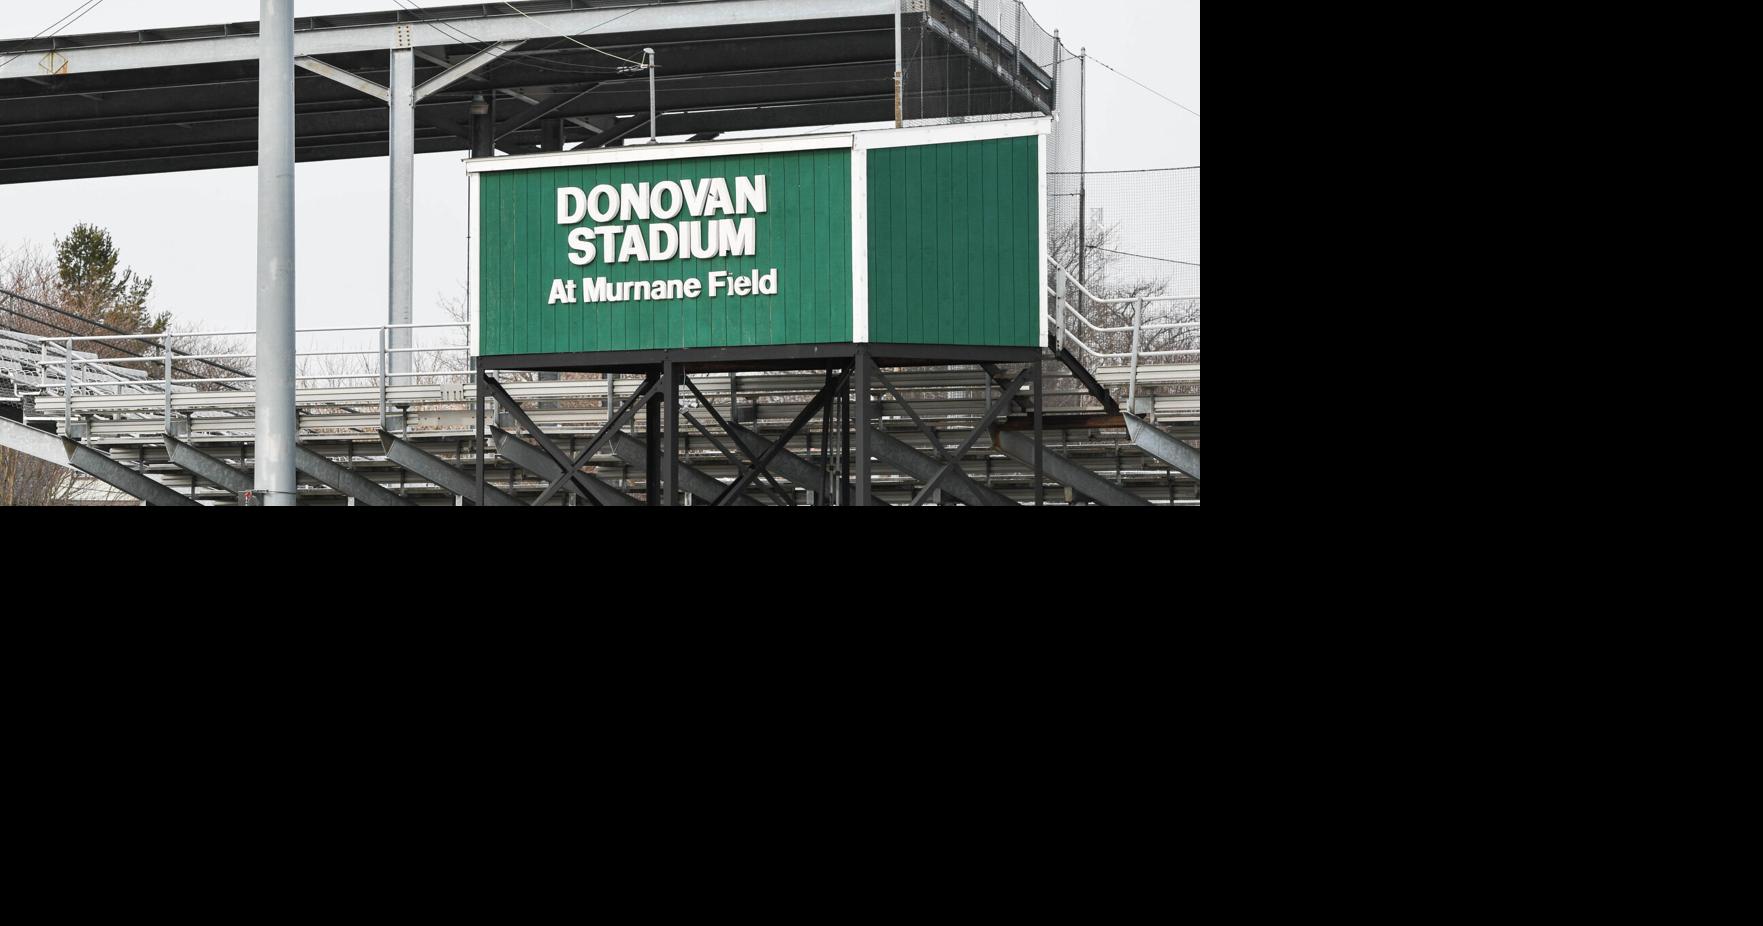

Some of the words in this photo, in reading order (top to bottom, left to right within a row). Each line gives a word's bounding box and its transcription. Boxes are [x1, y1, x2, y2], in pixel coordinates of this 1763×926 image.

[556, 174, 767, 225] DONOVAN
[567, 217, 756, 265] STADIUM
[547, 278, 577, 304] At
[583, 276, 702, 303] Murnane
[708, 268, 778, 297] Field
